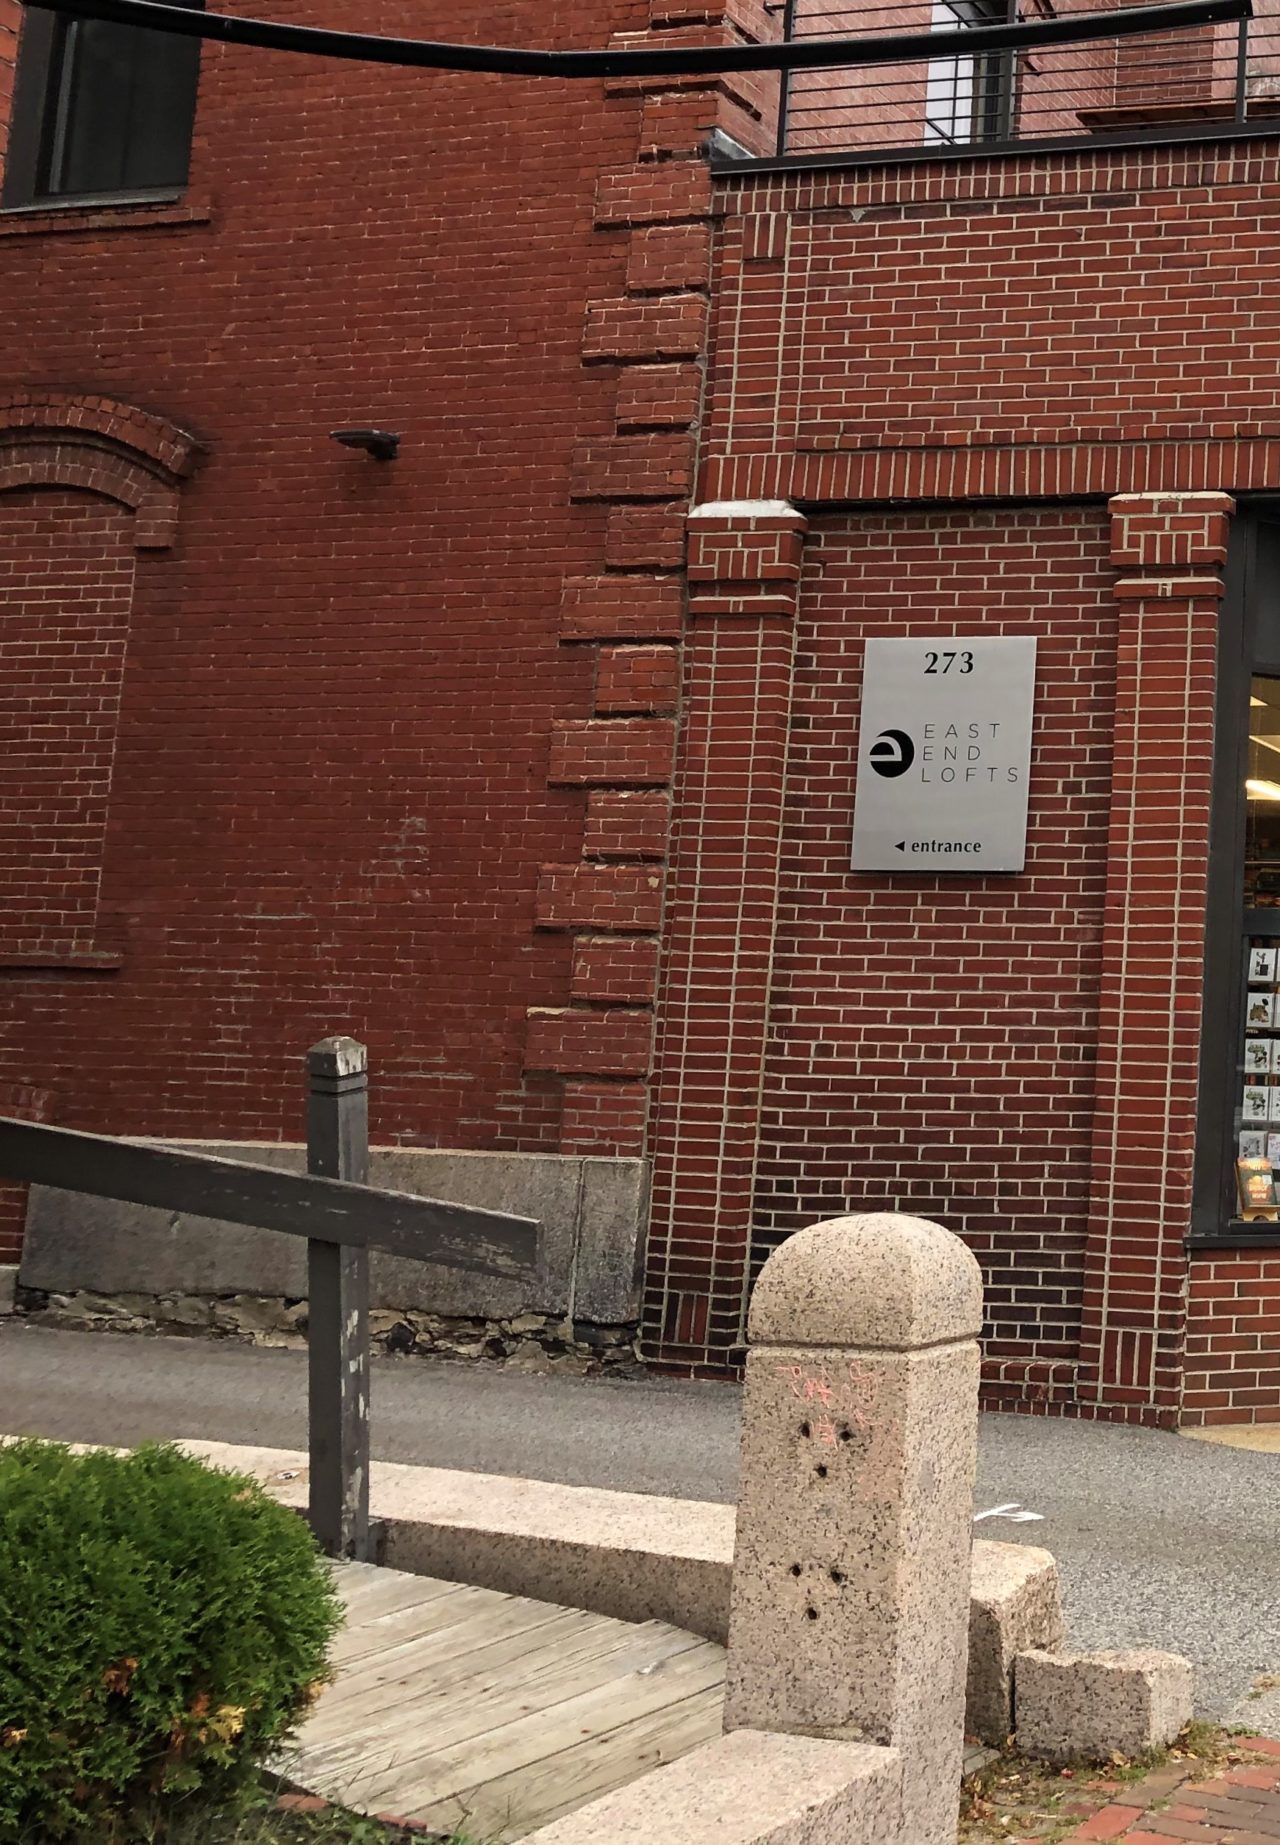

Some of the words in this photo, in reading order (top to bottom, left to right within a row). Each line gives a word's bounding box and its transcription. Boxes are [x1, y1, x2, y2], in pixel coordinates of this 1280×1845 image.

[923, 651, 975, 675] 273
[924, 723, 1001, 739] EAST
[922, 745, 981, 761] END
[920, 767, 1019, 783] LOFTS
[910, 839, 982, 854] entrance
